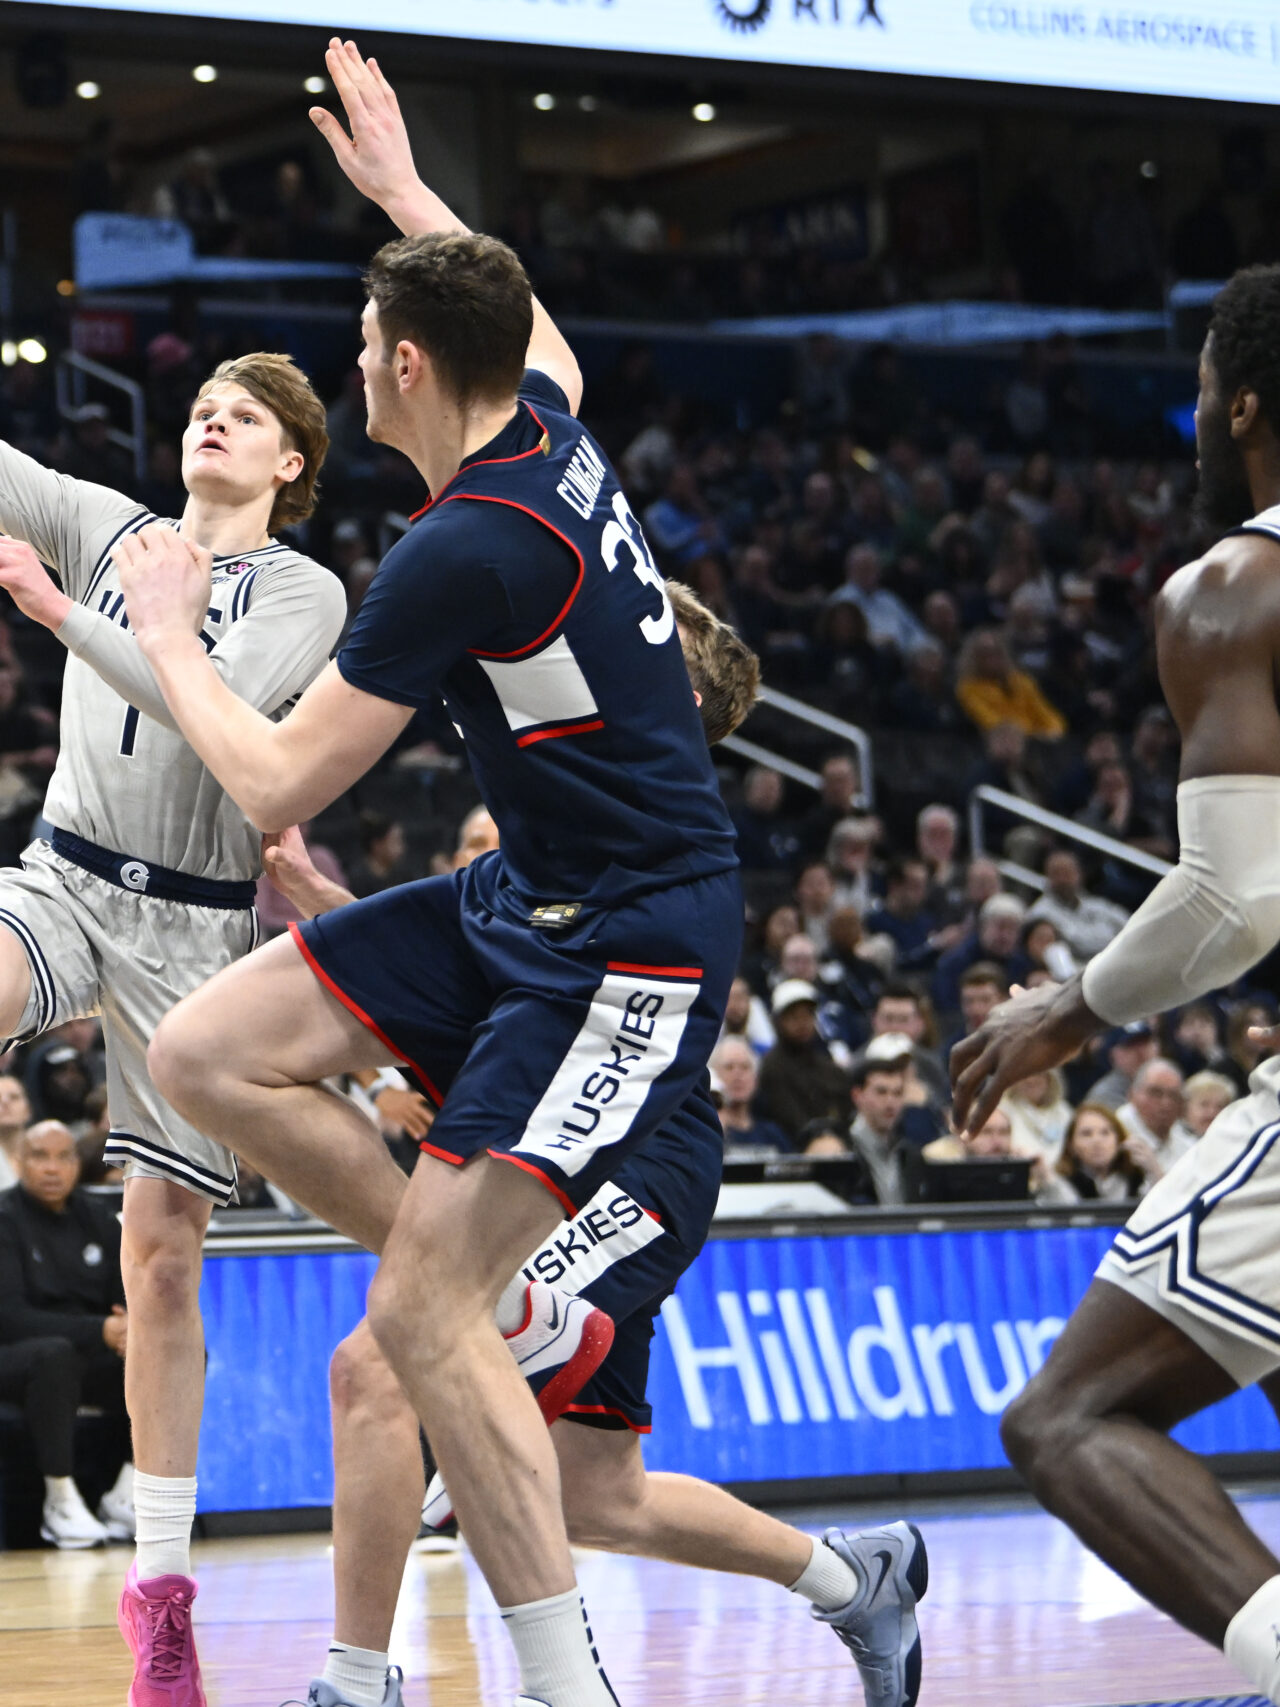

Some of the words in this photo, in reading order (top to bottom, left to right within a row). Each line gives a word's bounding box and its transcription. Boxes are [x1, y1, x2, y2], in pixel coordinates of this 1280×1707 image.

[969, 3, 1087, 40] COLLINS
[1093, 11, 1259, 57] AEROSPACE
[556, 434, 606, 521] CLINGAN
[120, 861, 150, 892] G
[545, 990, 665, 1152] HUSKIES
[522, 1195, 644, 1284] SKIES
